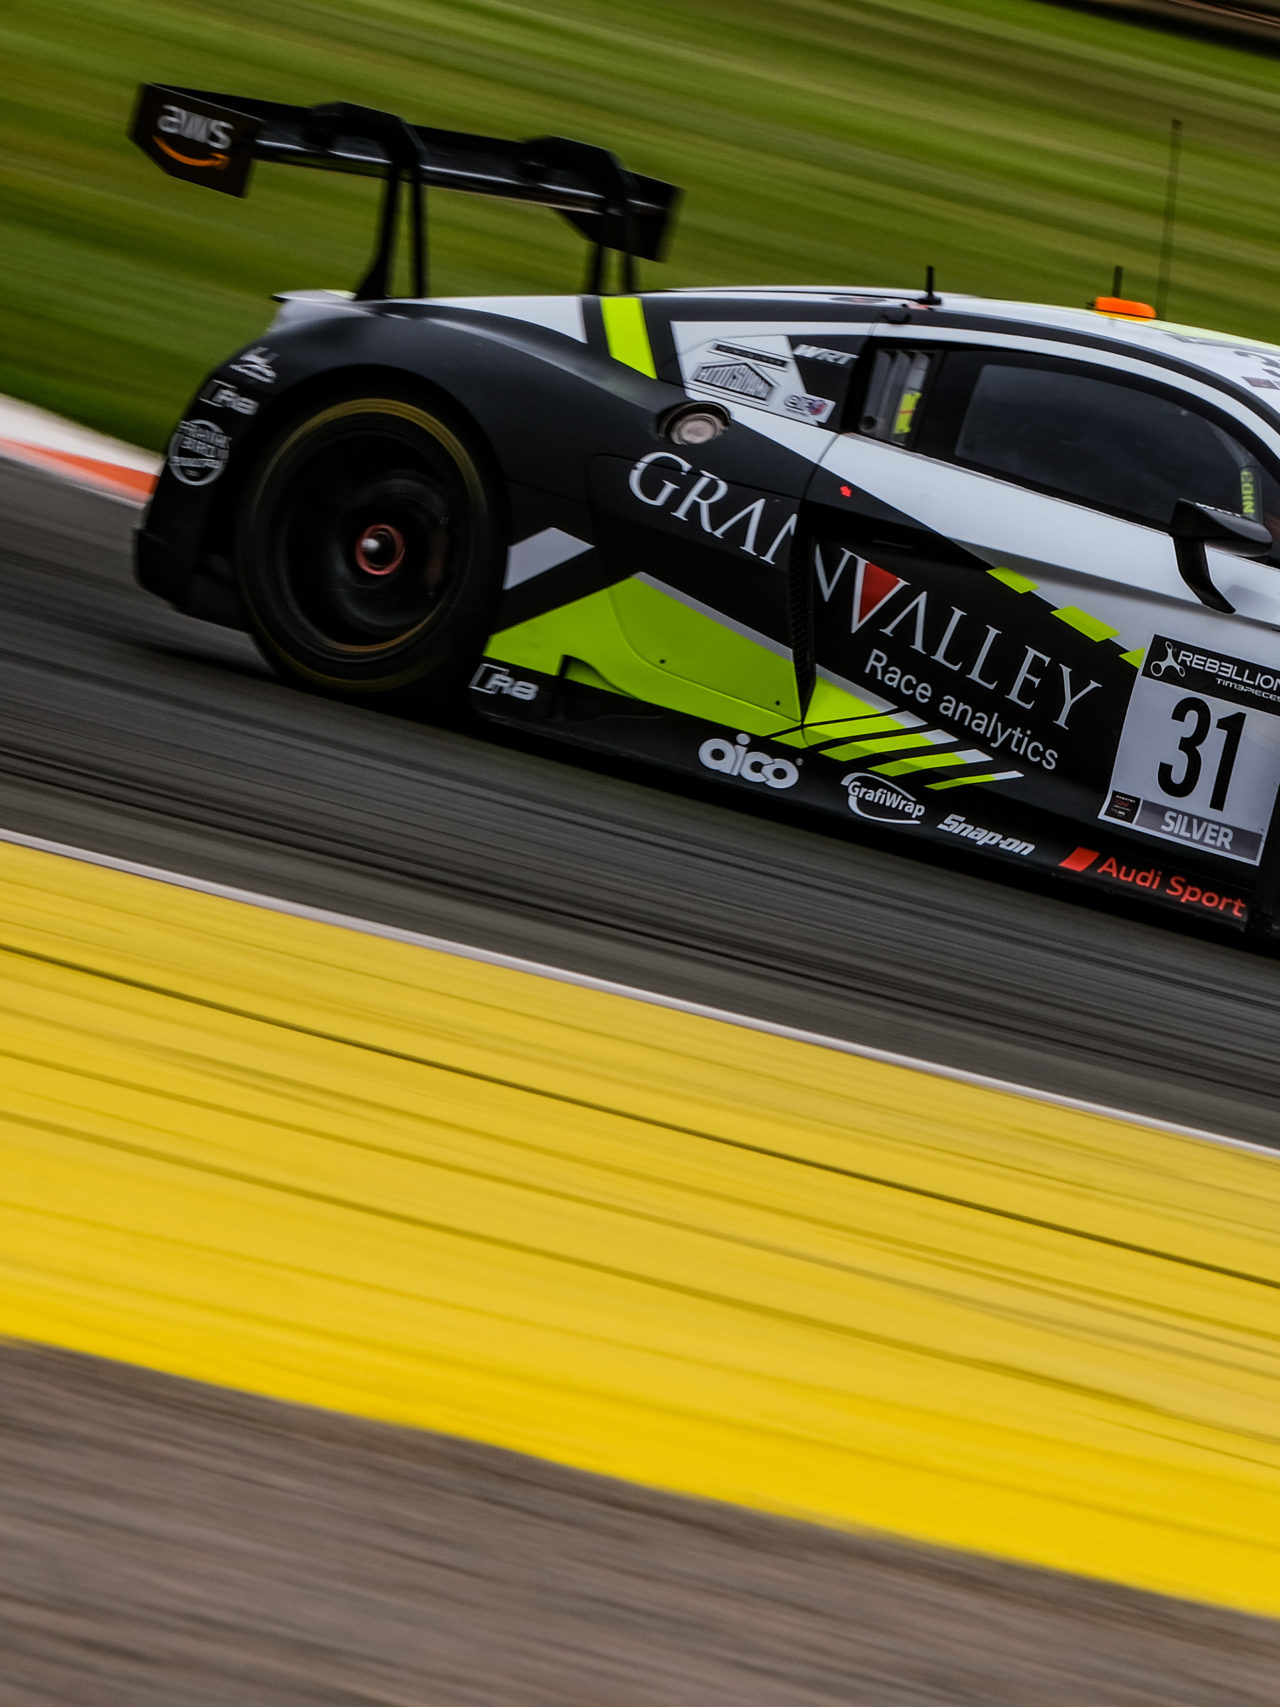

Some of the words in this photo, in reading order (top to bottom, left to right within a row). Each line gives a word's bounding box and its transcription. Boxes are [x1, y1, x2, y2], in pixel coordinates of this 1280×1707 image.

[157, 104, 235, 150] aws
[486, 672, 540, 700] R8
[863, 648, 933, 703] Race
[939, 693, 1059, 771] analytics
[699, 733, 799, 789] aico
[1157, 696, 1247, 812] 31
[848, 780, 926, 819] GrafiWrap
[936, 813, 1036, 856] Snap-on
[1160, 811, 1234, 850] SILVER
[1097, 855, 1162, 891] Audi
[1166, 874, 1248, 919] Sport
